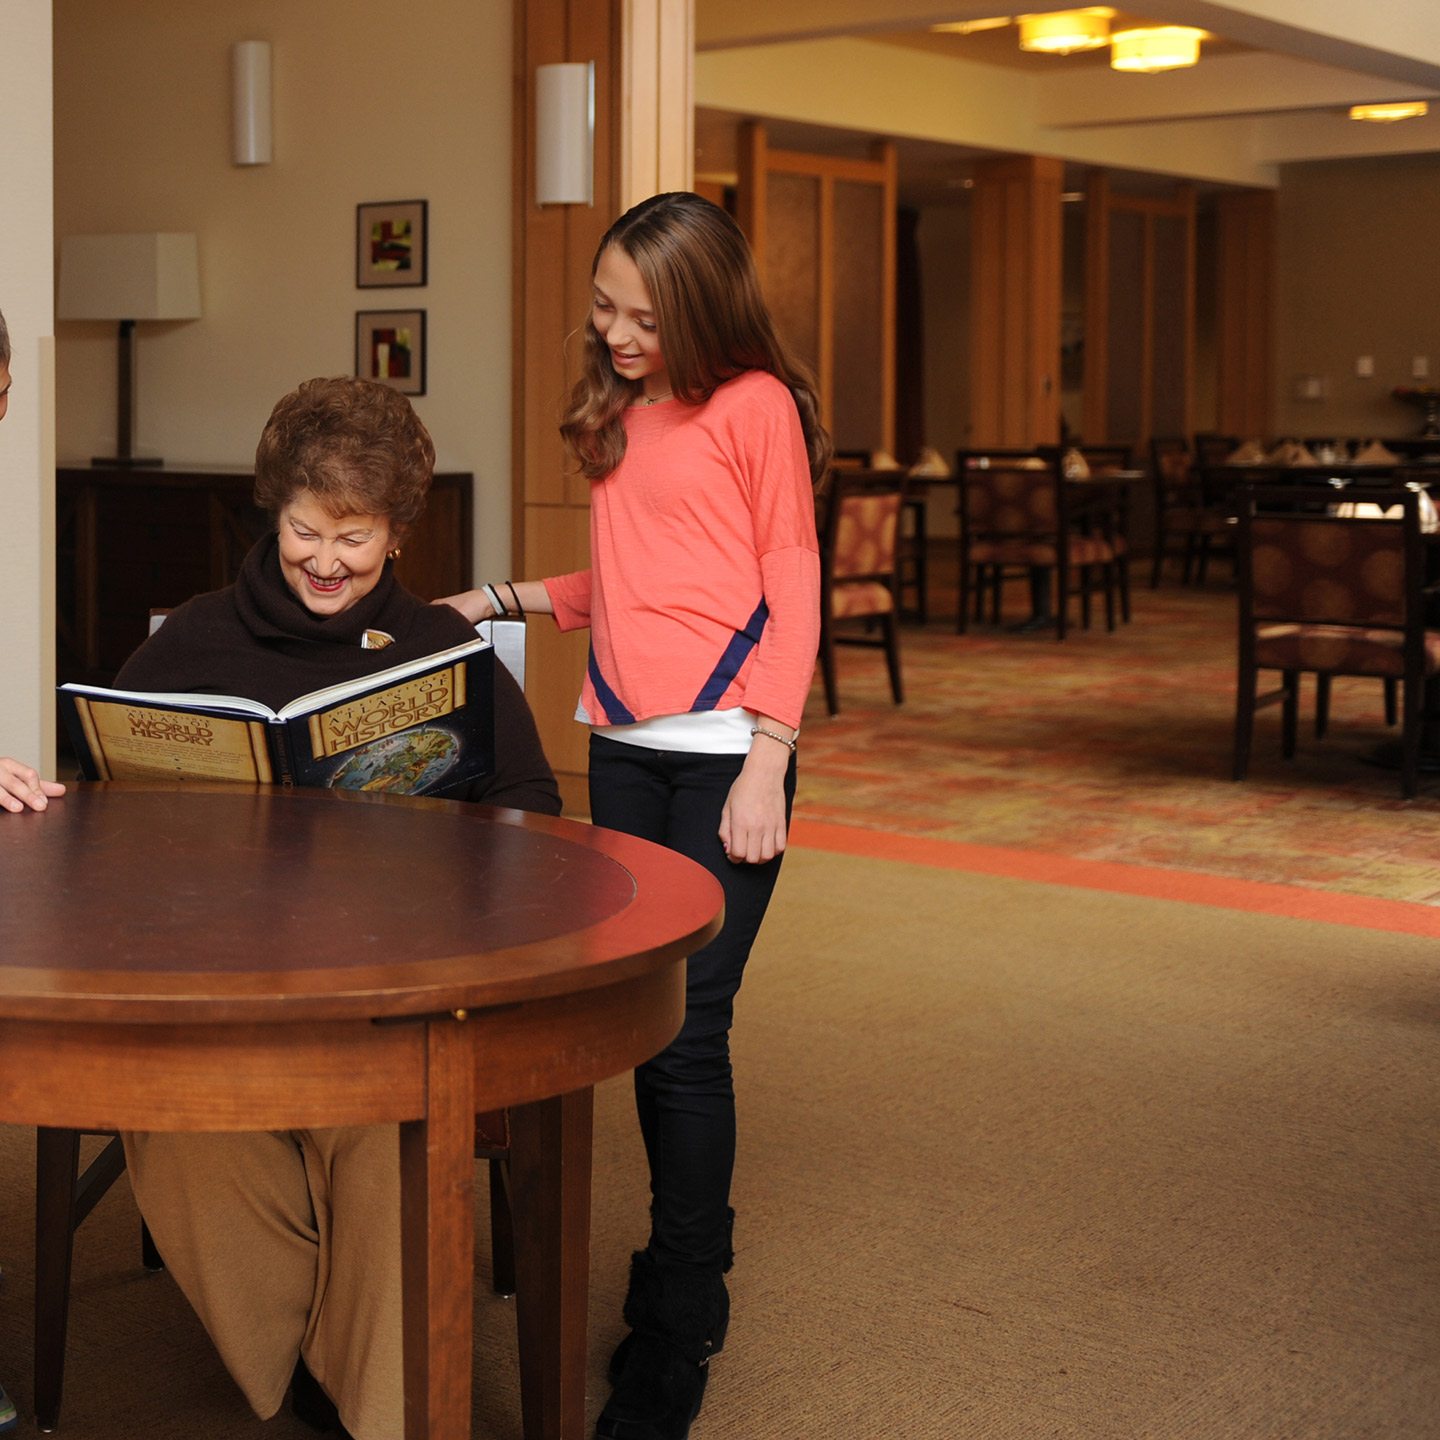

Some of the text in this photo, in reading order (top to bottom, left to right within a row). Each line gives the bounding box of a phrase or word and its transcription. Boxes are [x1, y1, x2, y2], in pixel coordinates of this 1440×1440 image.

[127, 718, 213, 738] WORLD
[329, 687, 449, 737] WORLD
[330, 698, 449, 753] HISTORY
[131, 727, 214, 747] HISTORY
